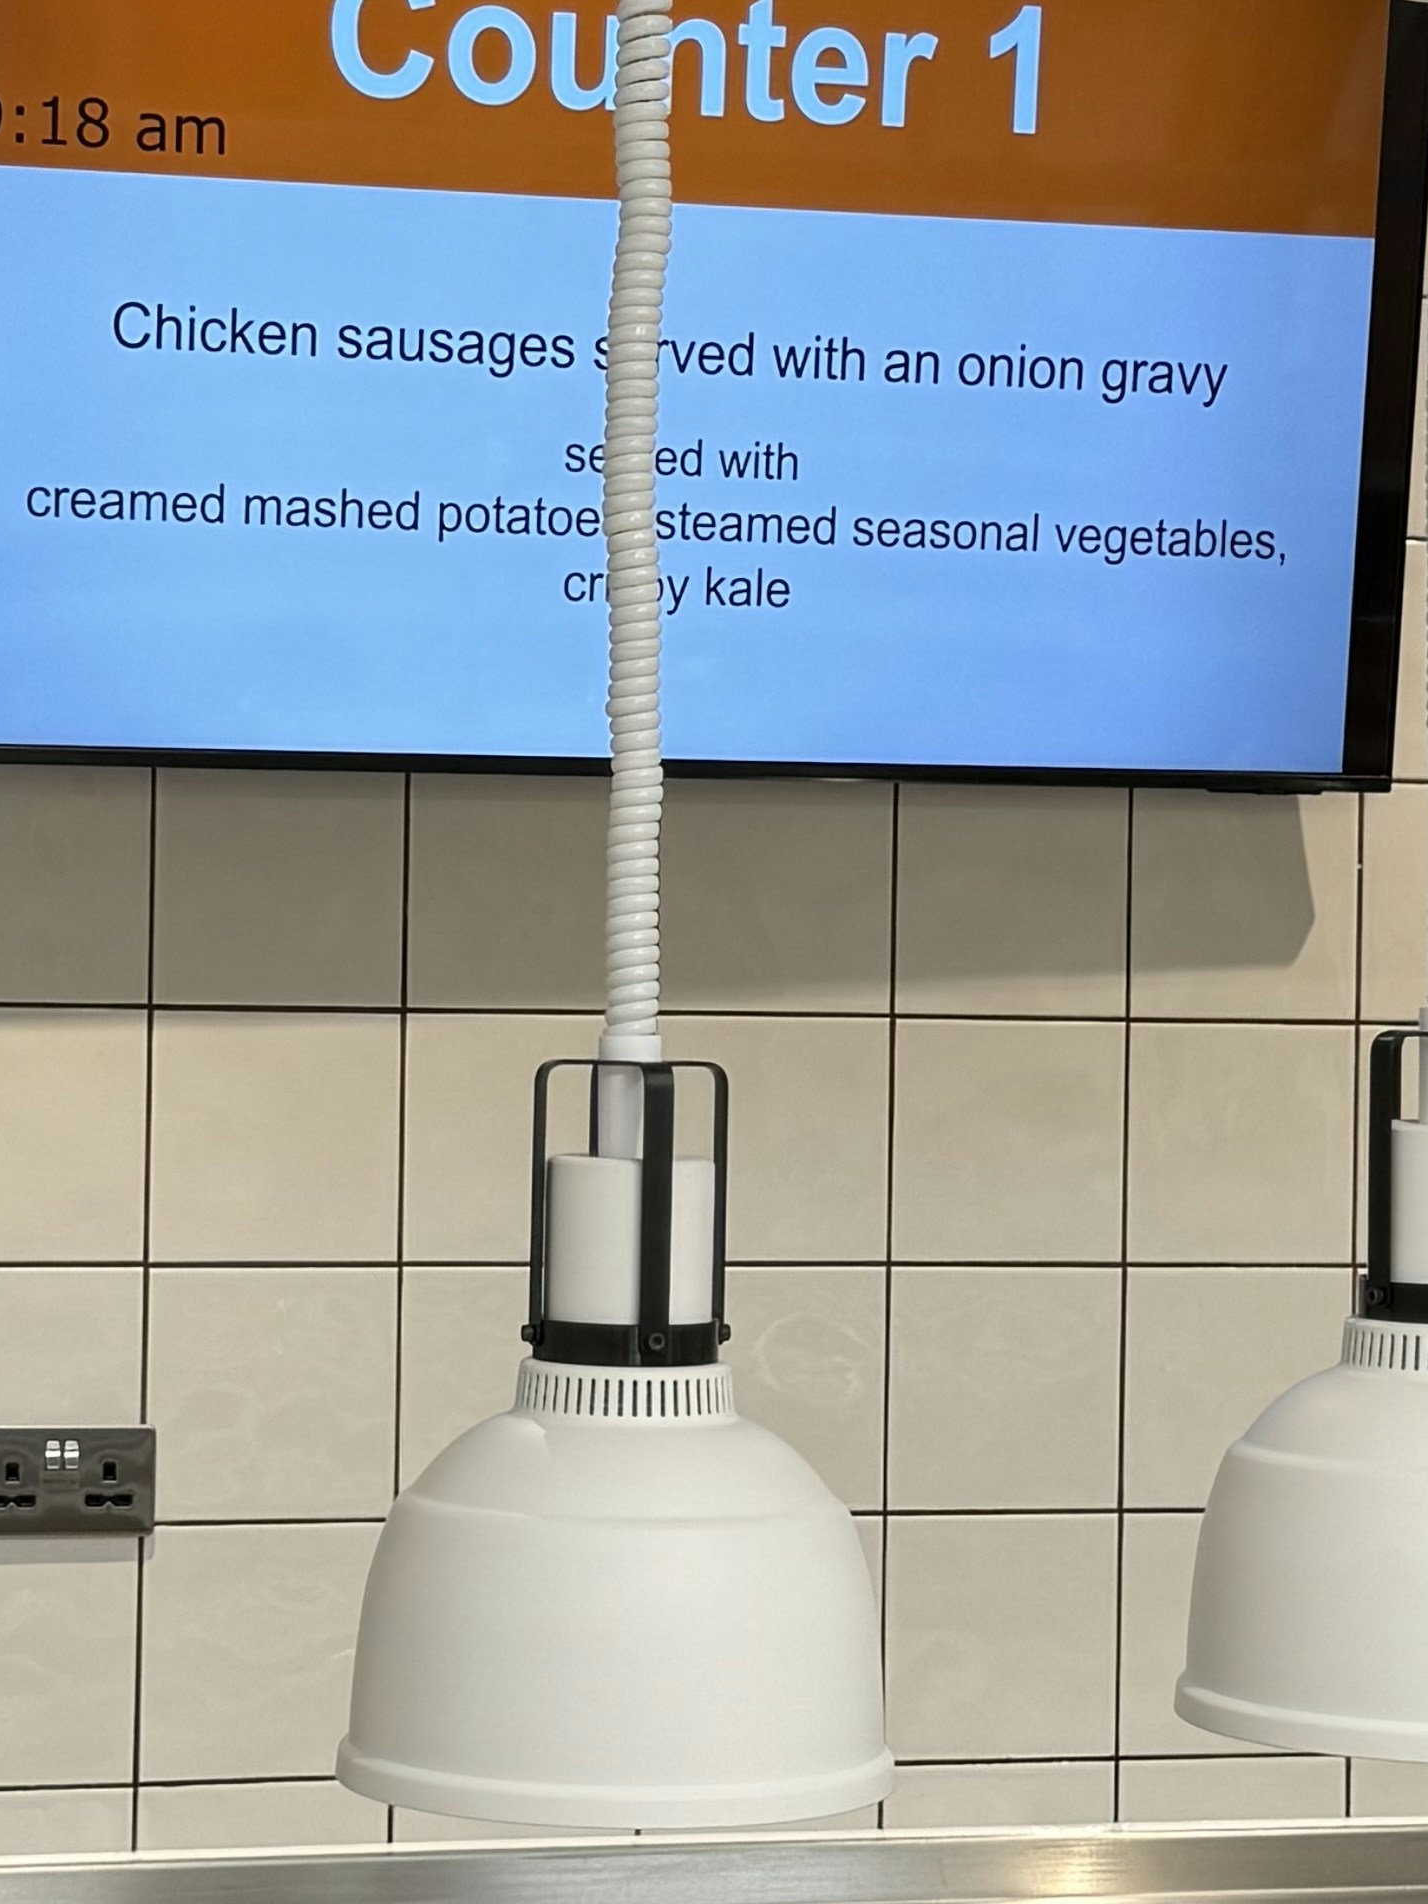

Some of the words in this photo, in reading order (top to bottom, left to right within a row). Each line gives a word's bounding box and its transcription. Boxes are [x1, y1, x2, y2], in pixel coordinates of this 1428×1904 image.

[989, 4, 1042, 135] 1
[136, 113, 226, 156] am
[114, 301, 316, 357] Chicken
[338, 325, 574, 378] sausages
[594, 332, 754, 376] srved
[773, 334, 864, 382] with
[884, 350, 939, 384] an
[959, 343, 1083, 390] onion
[1102, 359, 1228, 408] gravy
[565, 438, 703, 477] seed
[719, 441, 798, 481] with
[27, 483, 224, 524] creamed
[245, 488, 419, 531] mashed
[656, 502, 836, 546] steamed
[853, 513, 1039, 552] seasonal
[1055, 518, 1285, 567] vegetables,
[706, 566, 790, 609] kale
